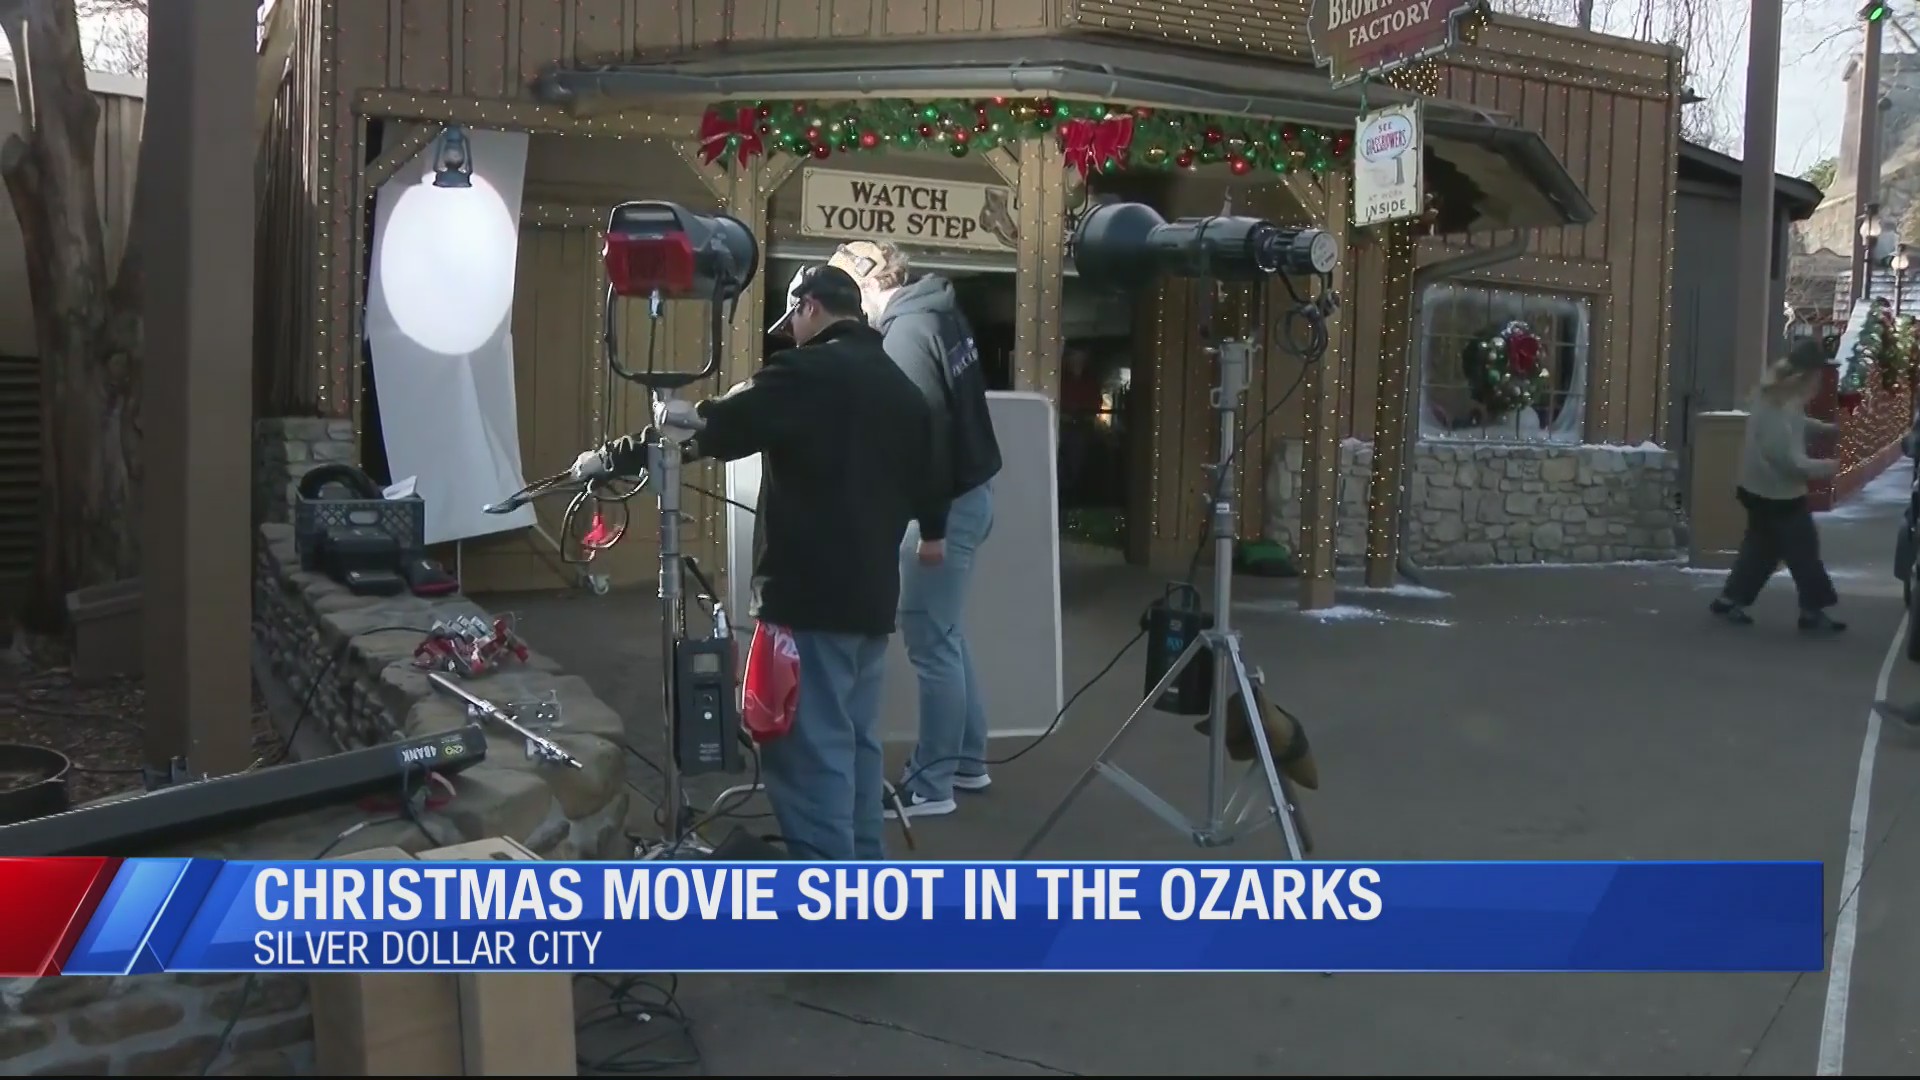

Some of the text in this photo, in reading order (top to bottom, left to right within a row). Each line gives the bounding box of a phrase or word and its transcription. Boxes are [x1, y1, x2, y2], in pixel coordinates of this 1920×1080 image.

[1349, 0, 1432, 48] FACTORY
[1378, 121, 1392, 134] SEE
[851, 181, 948, 212] WATCH
[1365, 198, 1407, 218] INSIDE
[817, 204, 976, 240] YOUR STEP
